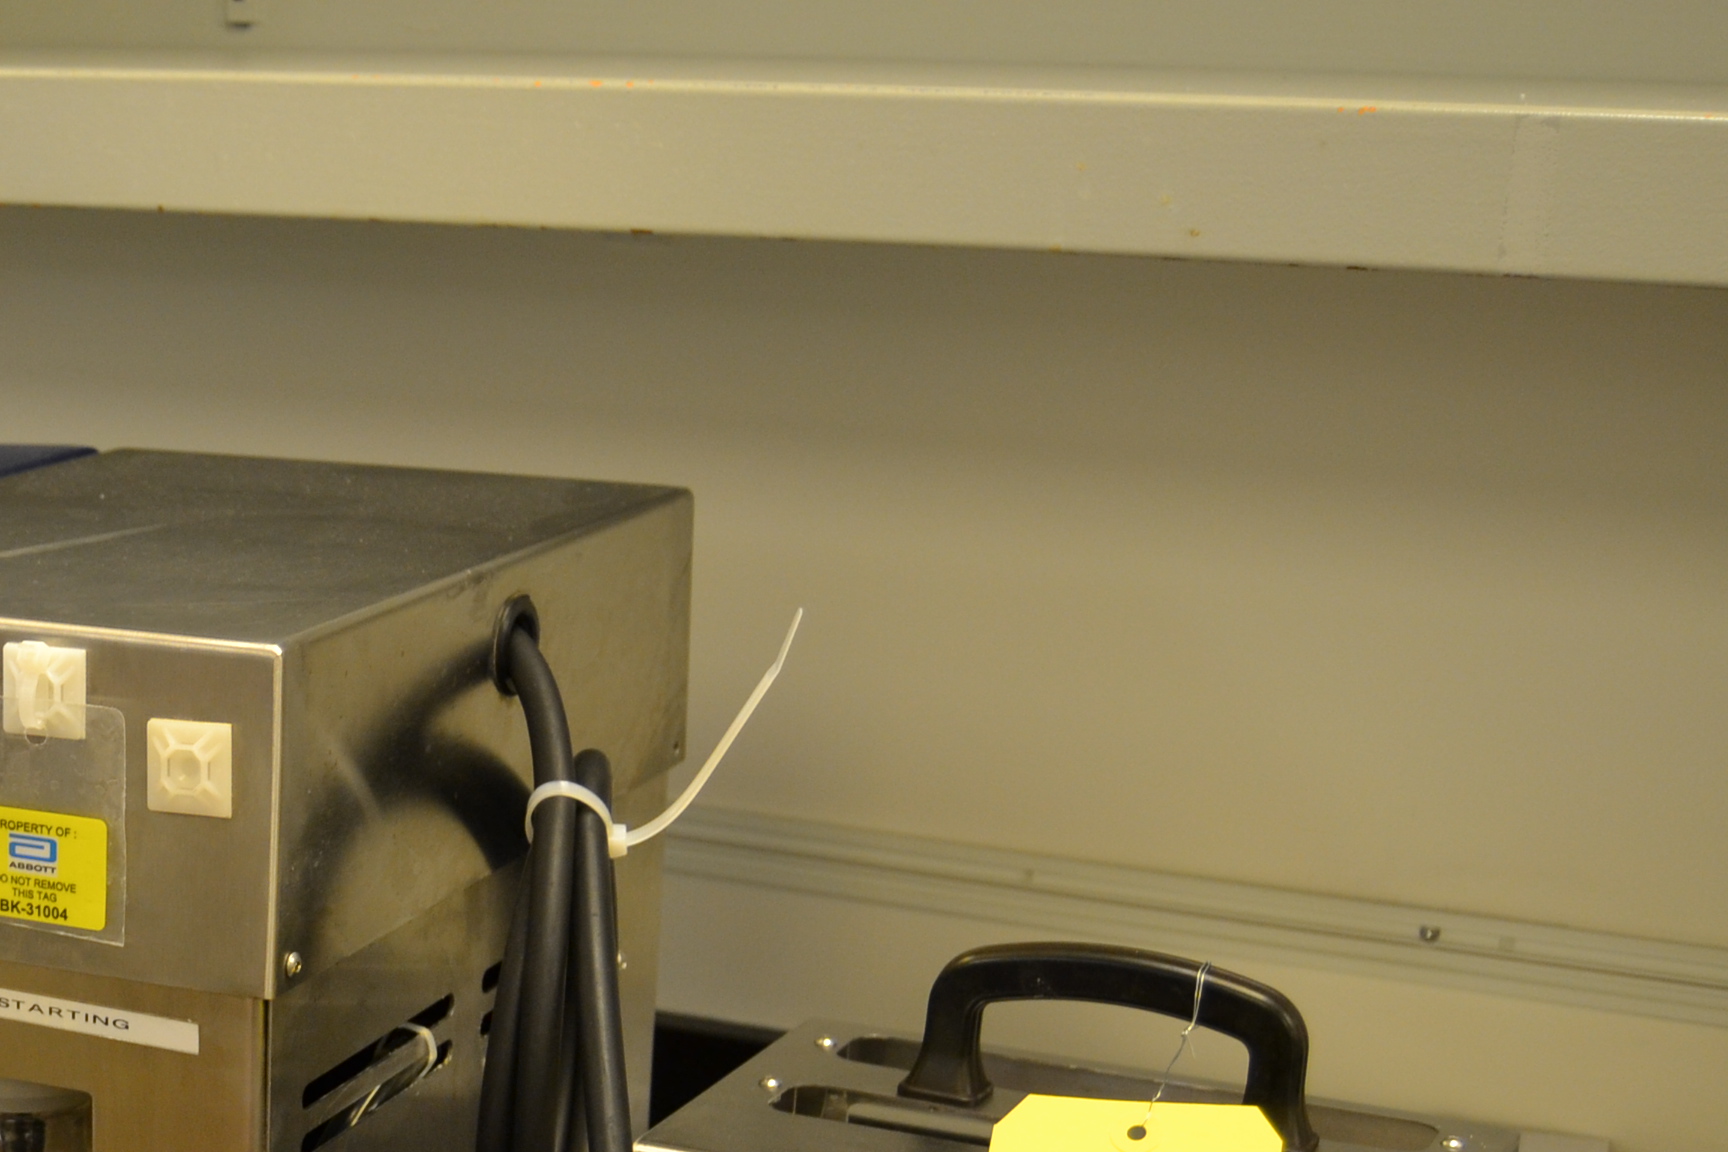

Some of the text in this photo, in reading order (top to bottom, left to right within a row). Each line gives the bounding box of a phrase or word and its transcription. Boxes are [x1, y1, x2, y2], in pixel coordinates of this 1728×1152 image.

[55, 826, 71, 838] OF
[9, 861, 56, 874] ABBOTT
[10, 876, 31, 887] NOT
[34, 879, 77, 894] REMOVE
[12, 887, 57, 903] THIS TAG
[0, 898, 68, 921] BK-31004
